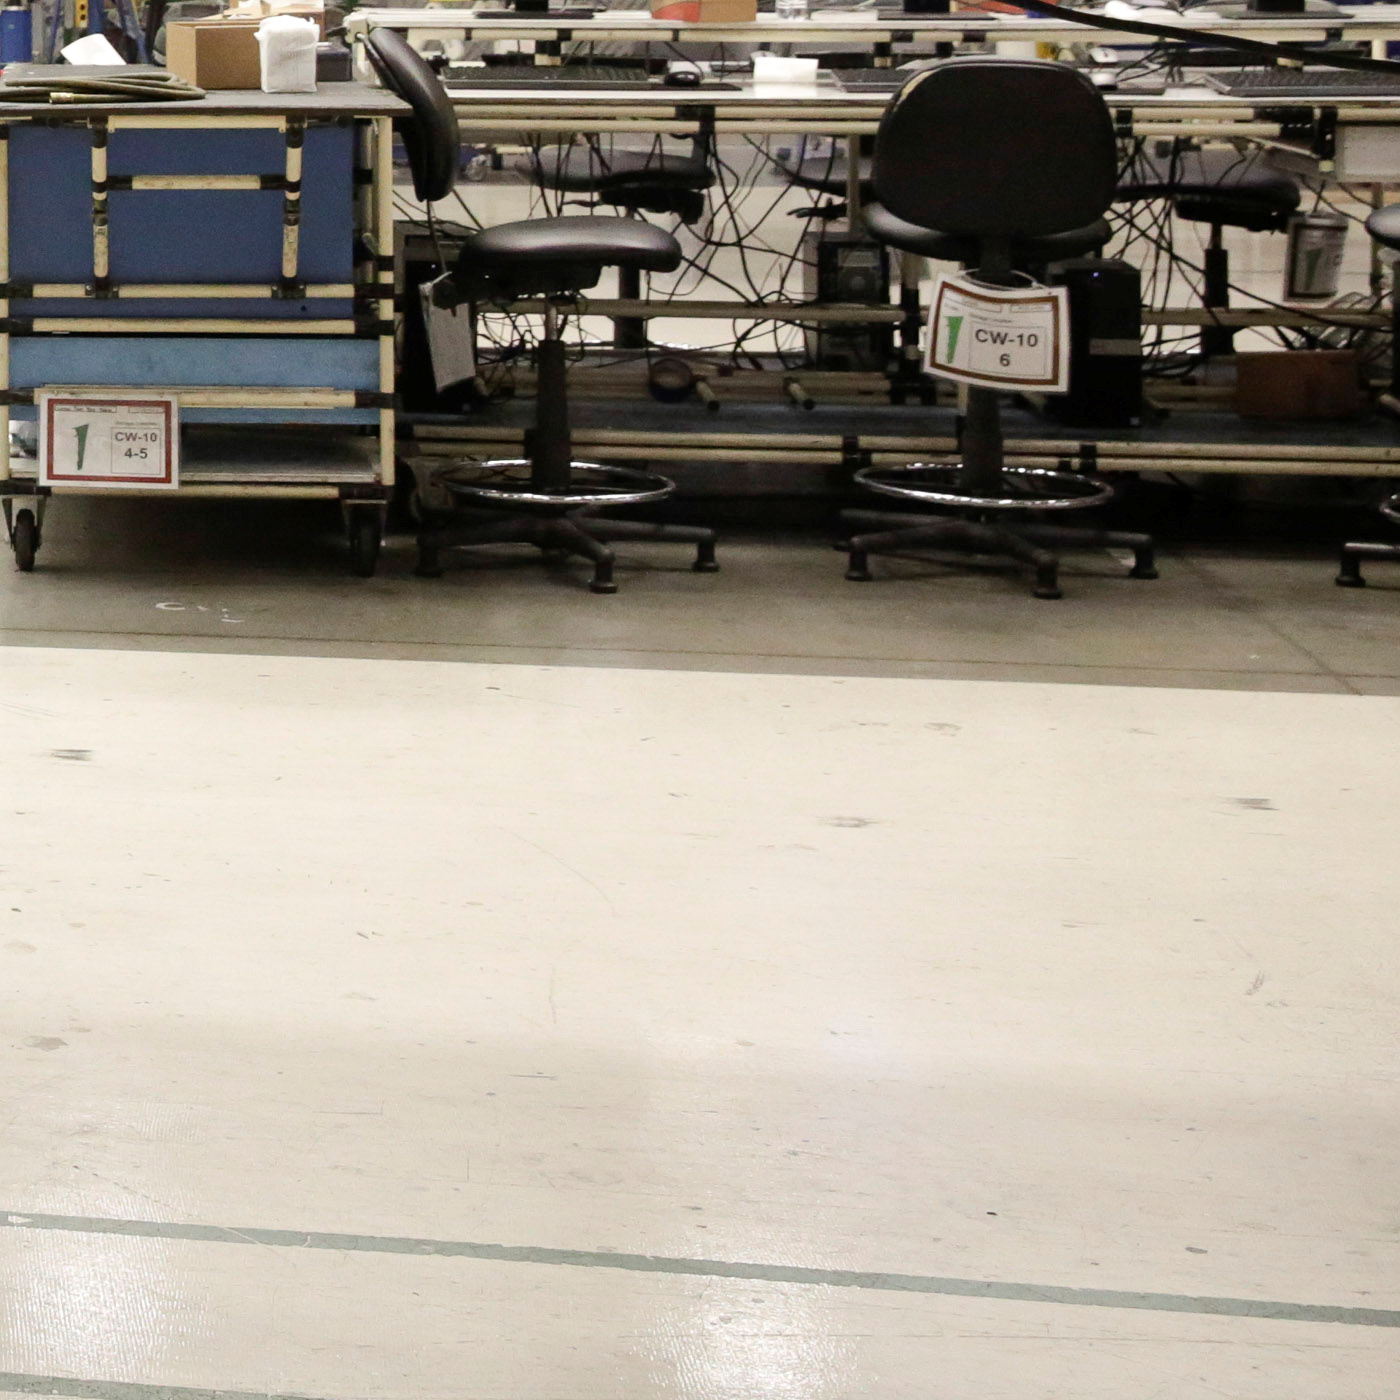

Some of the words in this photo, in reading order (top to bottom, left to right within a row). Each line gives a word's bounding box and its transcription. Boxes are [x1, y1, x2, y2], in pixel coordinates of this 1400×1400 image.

[975, 328, 1038, 347] CW-10
[1000, 353, 1011, 366] 6
[115, 432, 157, 442] CW-10
[124, 448, 148, 459] 4-5
